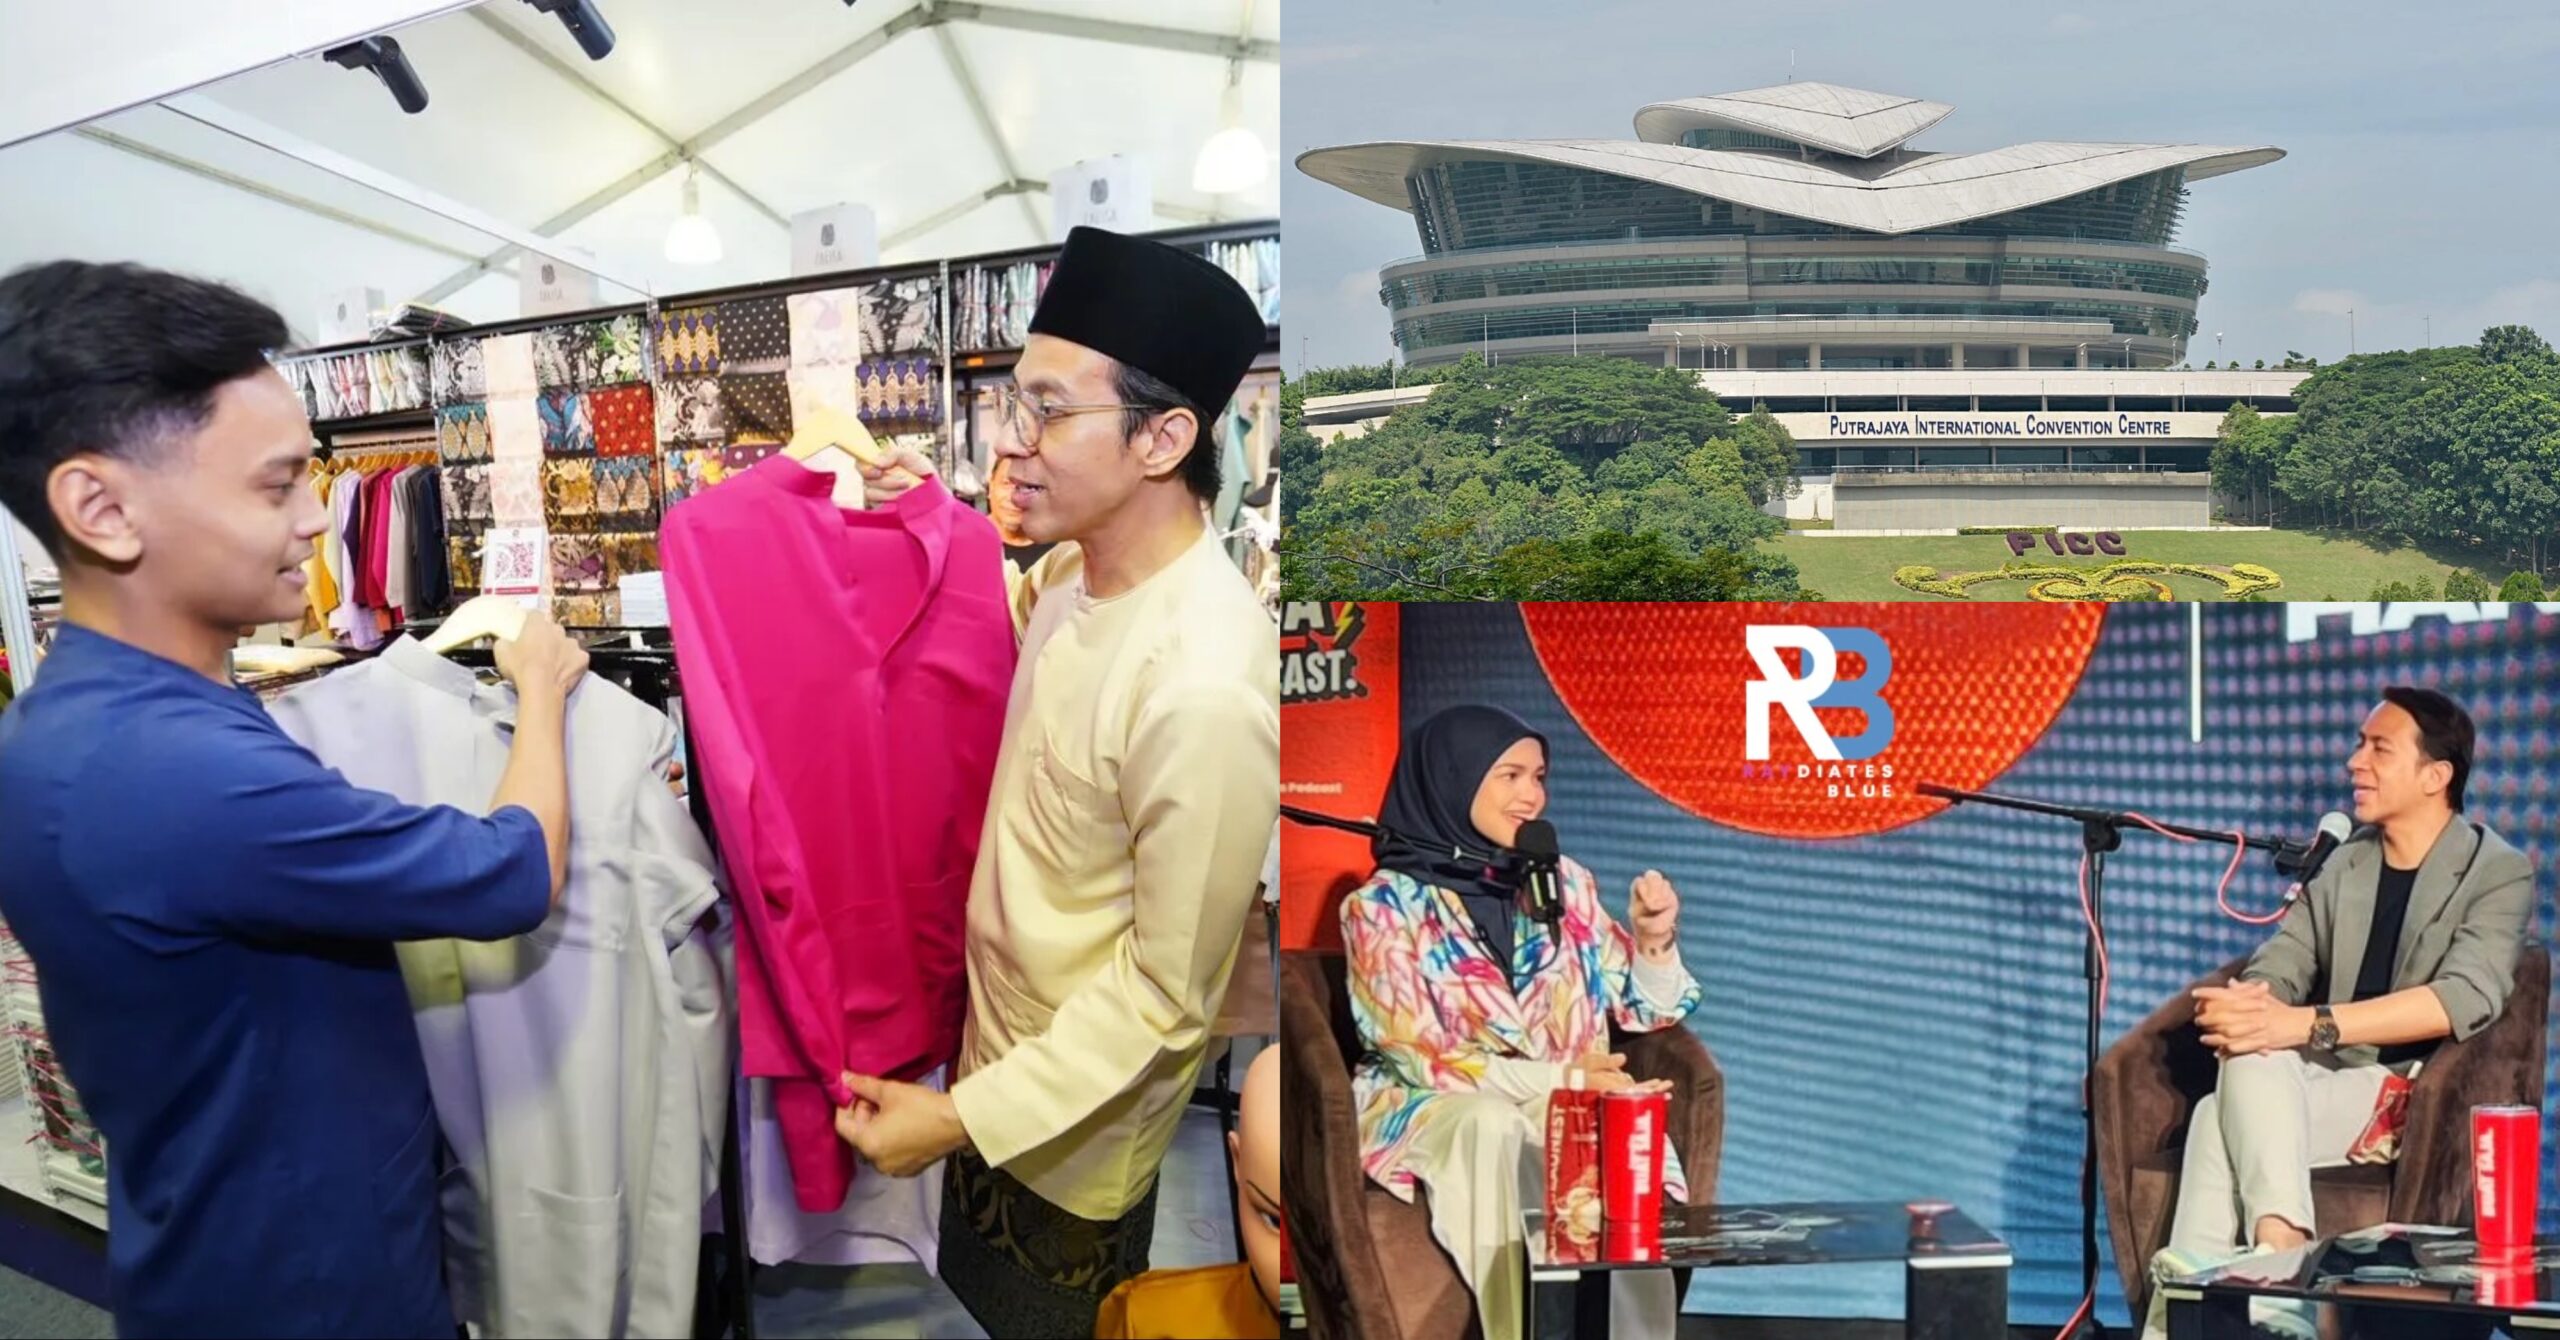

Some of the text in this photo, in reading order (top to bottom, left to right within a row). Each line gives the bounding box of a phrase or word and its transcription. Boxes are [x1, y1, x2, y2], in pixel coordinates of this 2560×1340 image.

[1830, 413, 2171, 435] PUTRAJAYA INTERNATIONAL CONVENTION CENTRE
[2006, 531, 2127, 557] PICC
[1280, 649, 1357, 696] AST.
